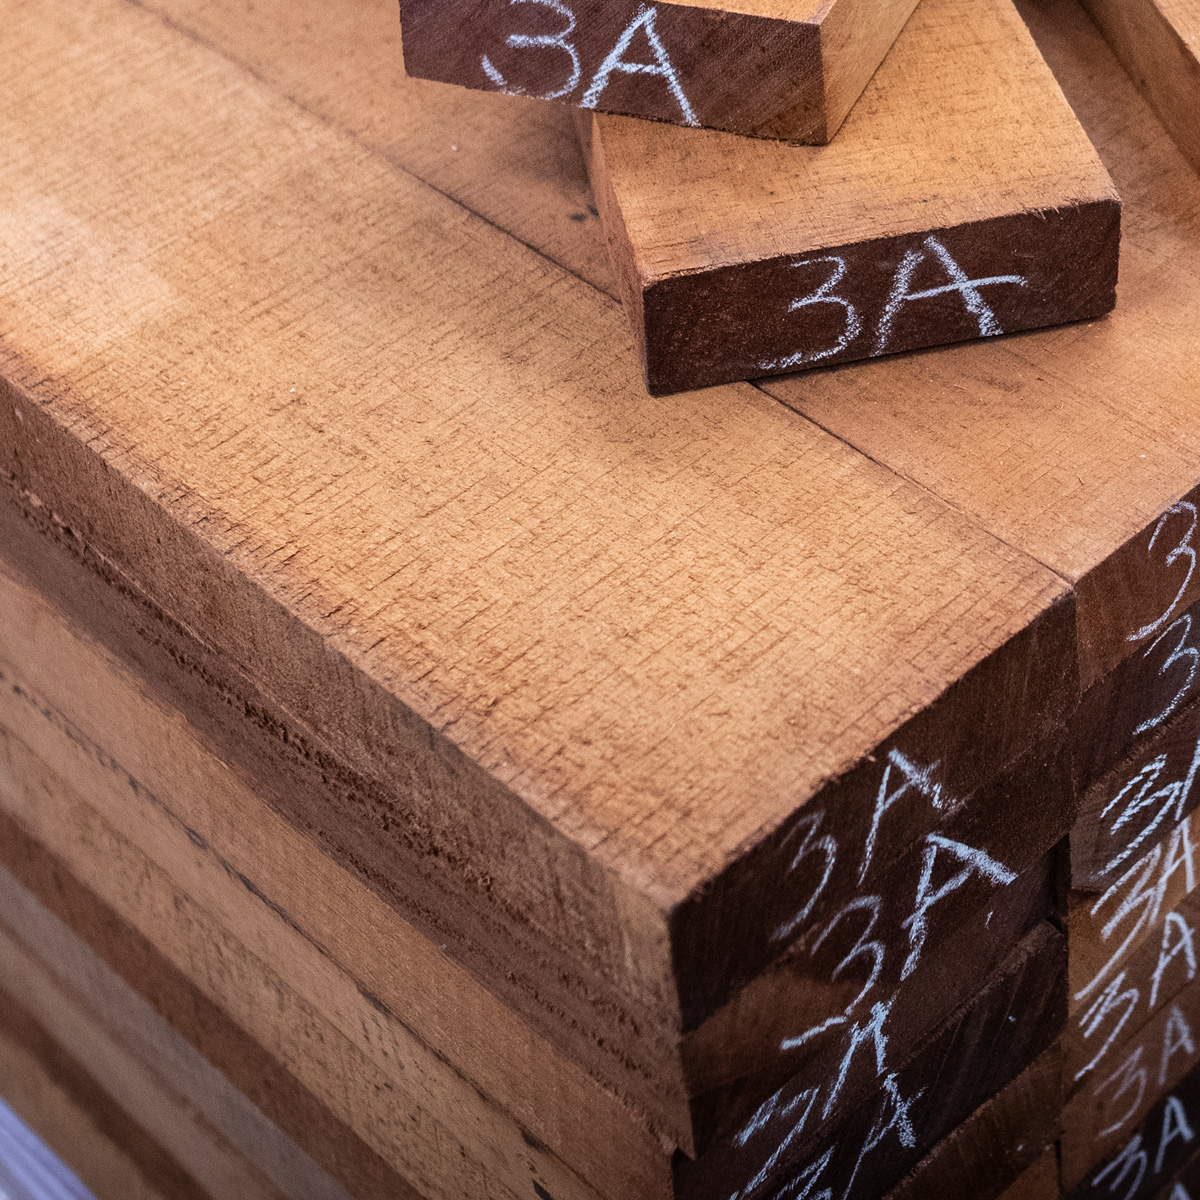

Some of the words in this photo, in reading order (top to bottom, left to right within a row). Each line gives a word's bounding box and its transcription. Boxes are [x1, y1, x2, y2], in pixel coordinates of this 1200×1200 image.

[757, 216, 1028, 371] 3A
[770, 748, 967, 942] 3A
[1074, 817, 1200, 1000] 3A
[780, 832, 1018, 1050] 3A
[1074, 912, 1197, 1081] 3A
[1090, 1097, 1195, 1200] 3A
[1092, 1005, 1195, 1138] 3A
